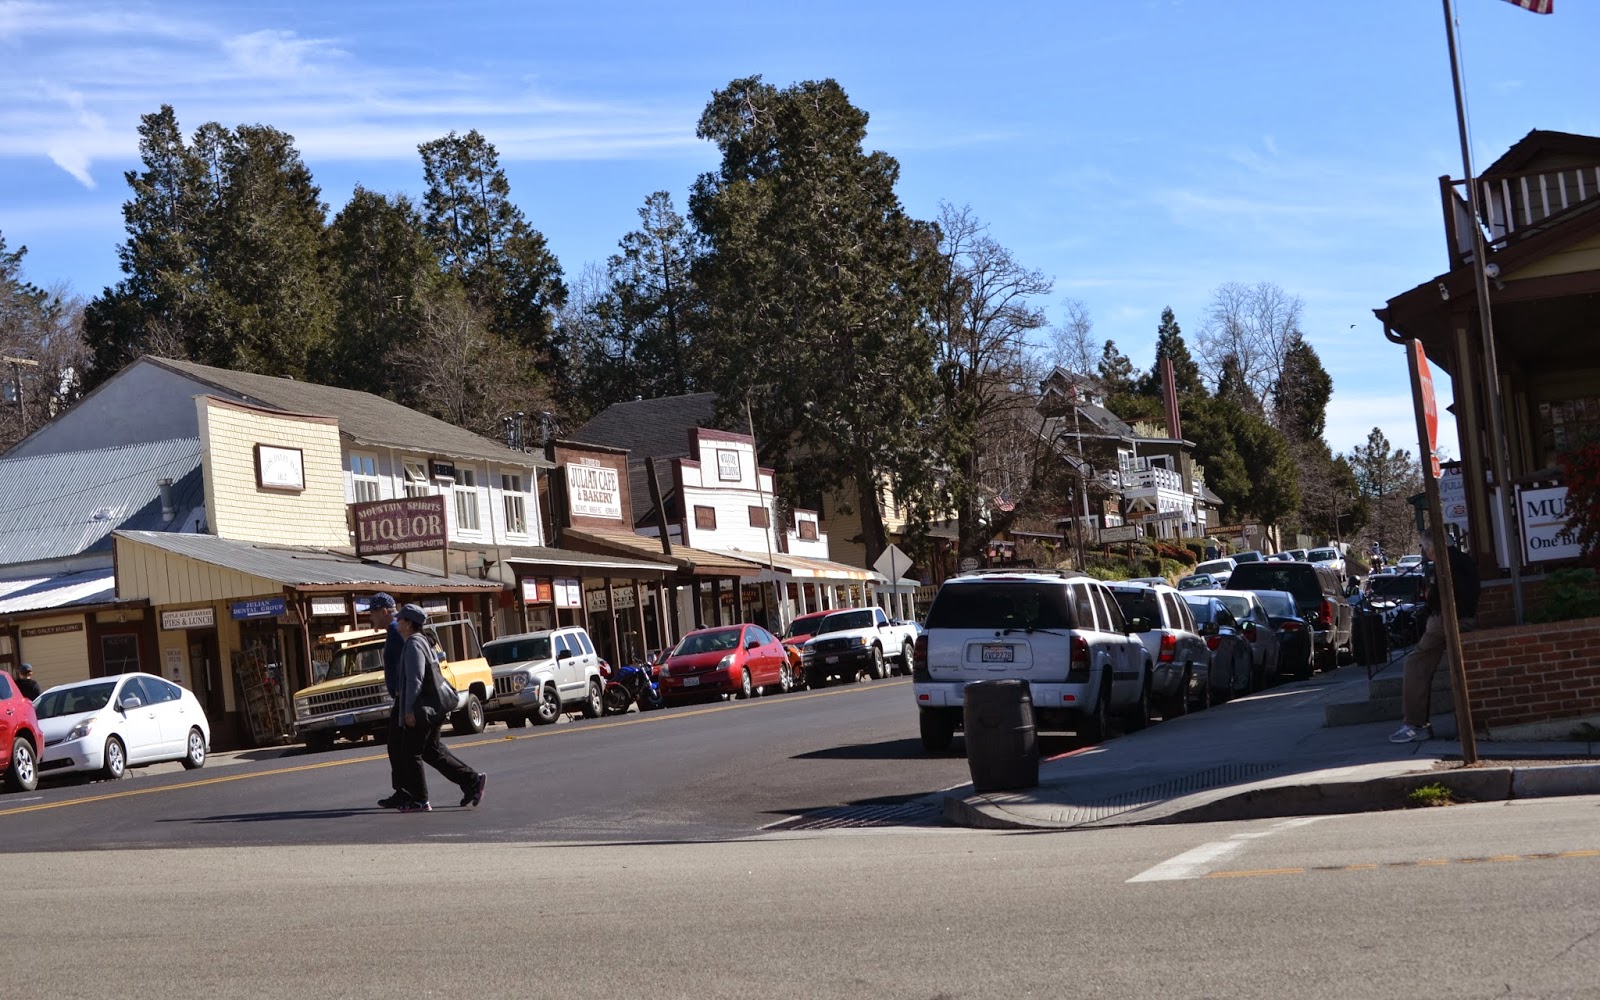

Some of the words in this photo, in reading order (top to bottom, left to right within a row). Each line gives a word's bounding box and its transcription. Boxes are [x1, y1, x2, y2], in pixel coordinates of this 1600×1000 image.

[571, 468, 598, 489] JULIAN
[599, 471, 616, 491] CAFE
[577, 489, 582, 500] &
[583, 490, 613, 504] BAKERY
[359, 503, 401, 519] MOUNTAIN
[407, 502, 441, 511] SPIRITS
[360, 515, 441, 542] LIQUOR
[1530, 536, 1558, 549] One
[233, 607, 258, 615] DENTAL
[261, 604, 283, 612] GROUP
[164, 619, 180, 628] PIES
[182, 618, 187, 626] &
[189, 615, 213, 625] LUNCH
